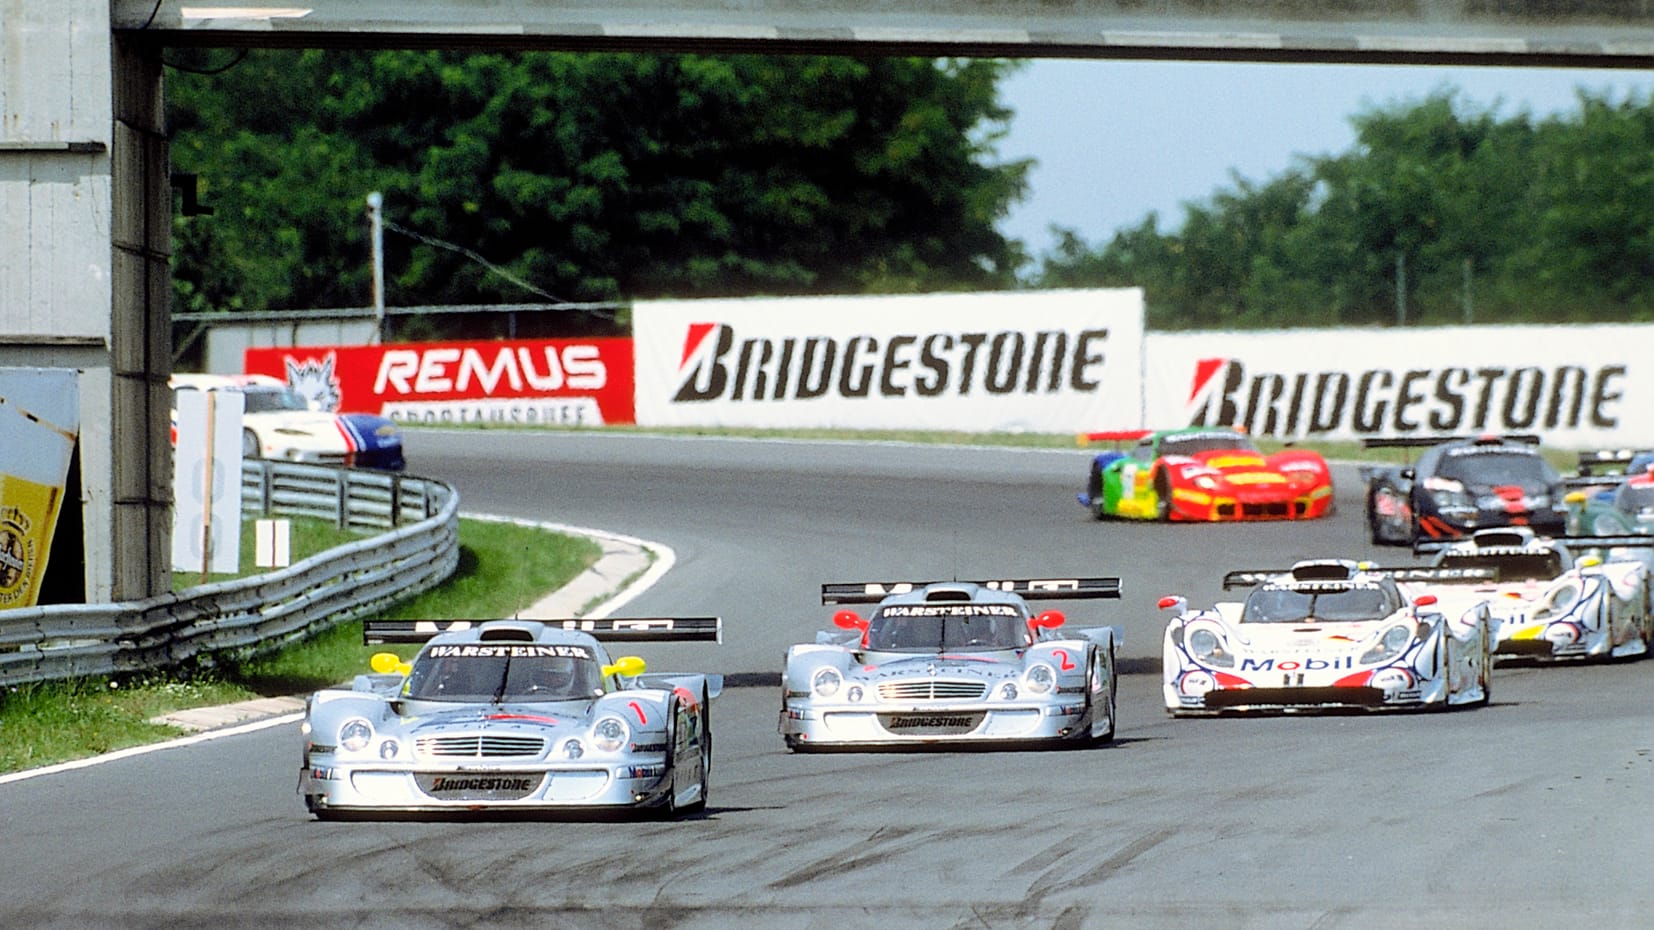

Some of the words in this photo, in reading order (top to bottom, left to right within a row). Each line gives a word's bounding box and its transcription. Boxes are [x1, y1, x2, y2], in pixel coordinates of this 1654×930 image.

[373, 344, 607, 394] REMUS
[671, 323, 1109, 403] BRIDGESTONE
[1186, 358, 1627, 436] BRIDGESTONE
[882, 605, 1018, 618] WARSTEINER
[430, 645, 590, 659] WARSTEINER
[1052, 650, 1075, 671] 2
[1240, 655, 1353, 672] Mobil
[628, 702, 647, 725] 1
[889, 716, 973, 729] BRIDGESTONE
[430, 777, 532, 792] BRIDGESTONE
